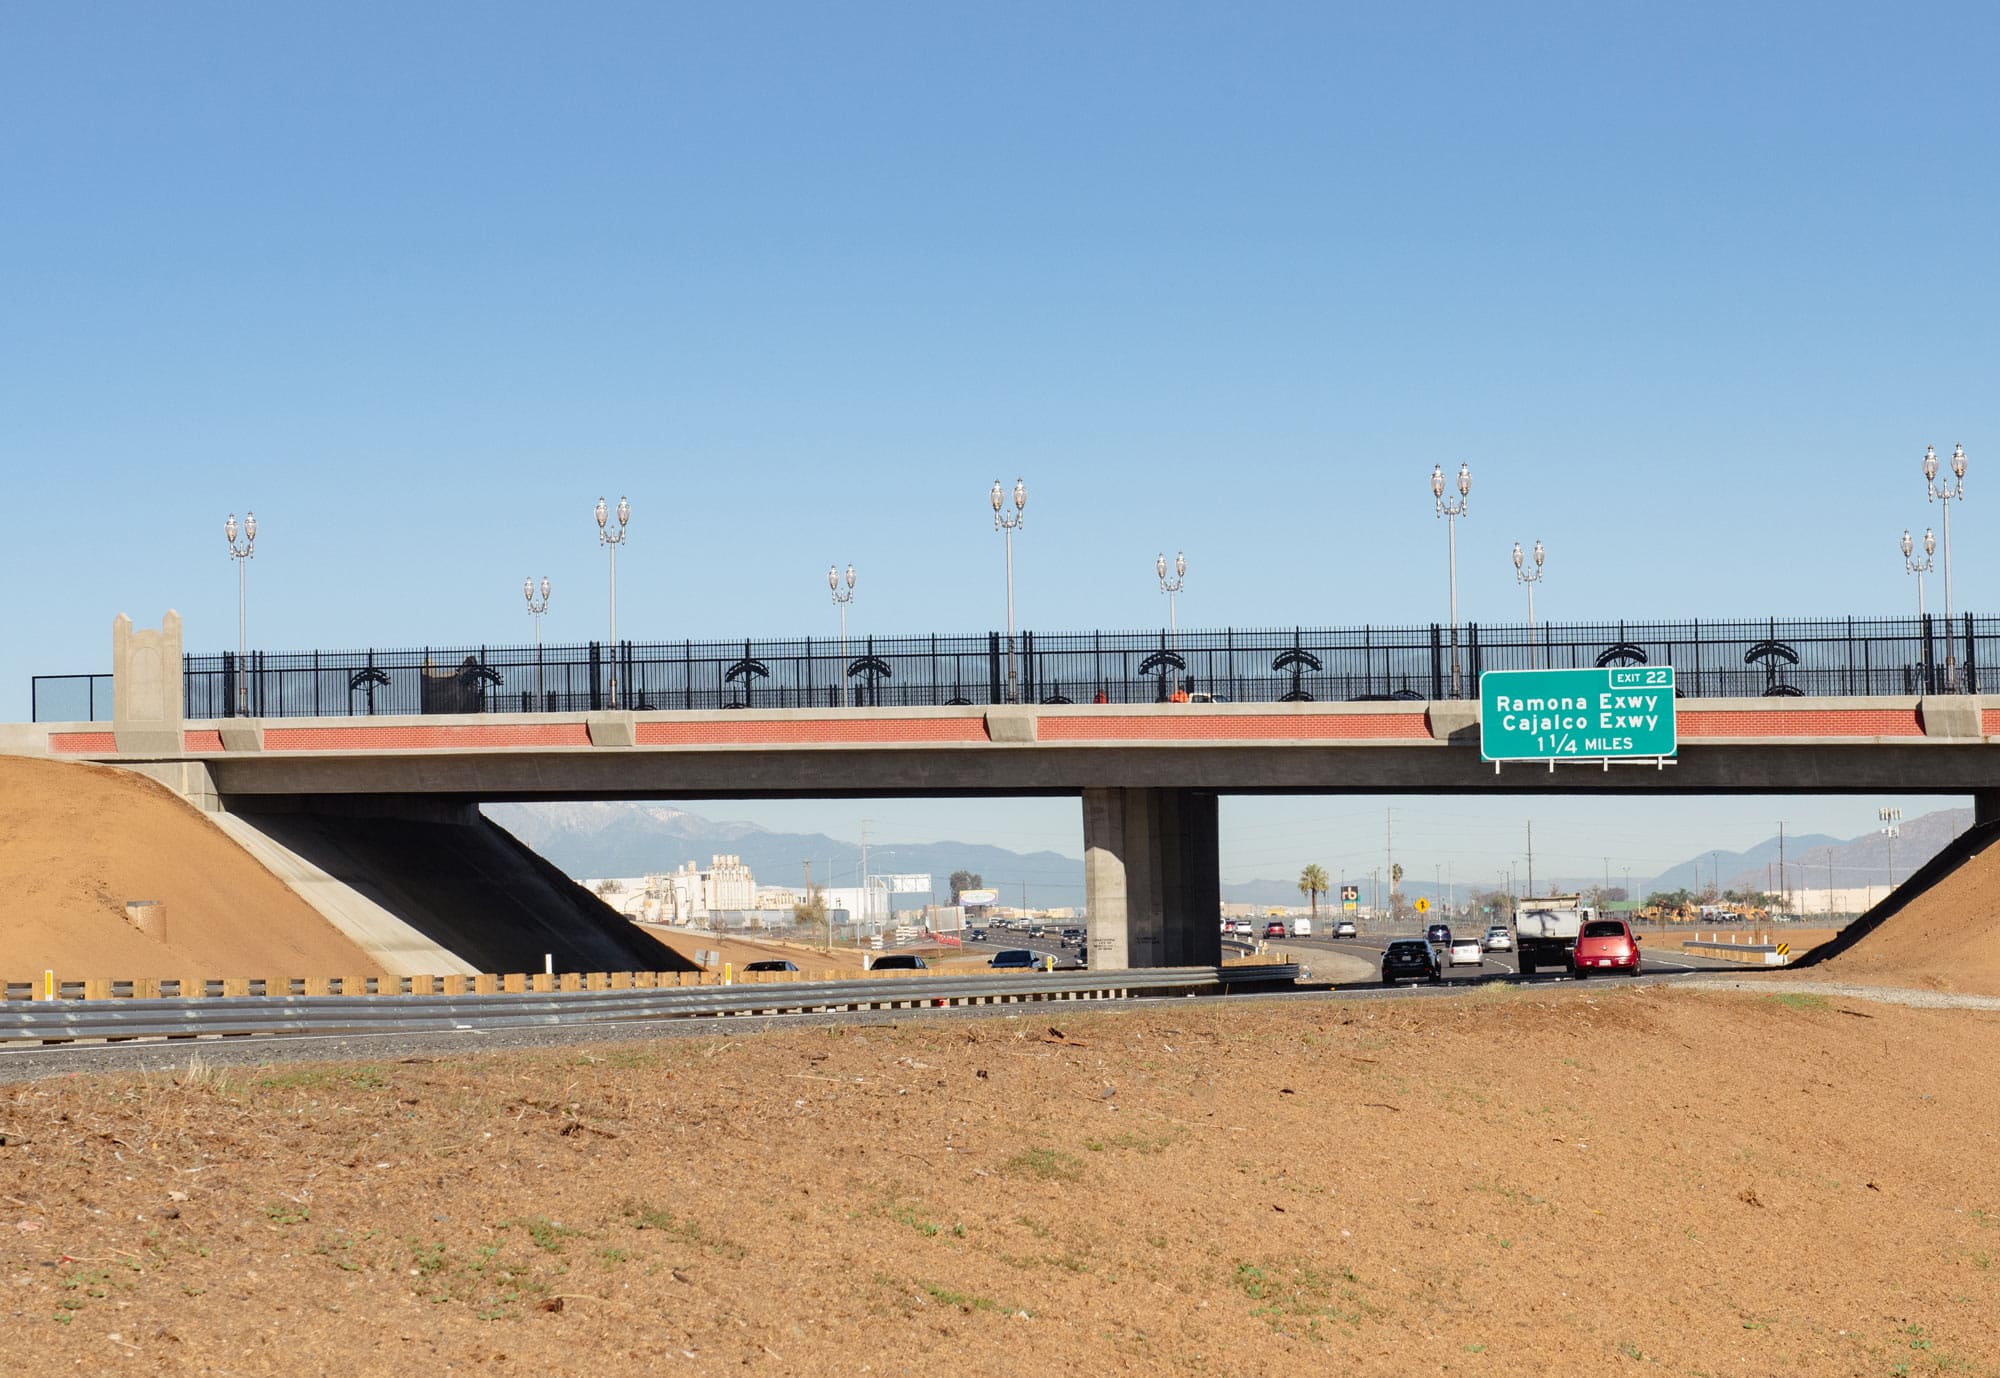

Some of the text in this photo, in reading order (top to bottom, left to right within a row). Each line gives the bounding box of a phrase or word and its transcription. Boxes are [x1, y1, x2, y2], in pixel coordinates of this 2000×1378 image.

[1617, 671, 1667, 684] EXIT 22
[1497, 693, 1659, 712] Ramona Exwy
[1503, 713, 1659, 735] Cajalco Exwy
[1585, 737, 1633, 750] MILES
